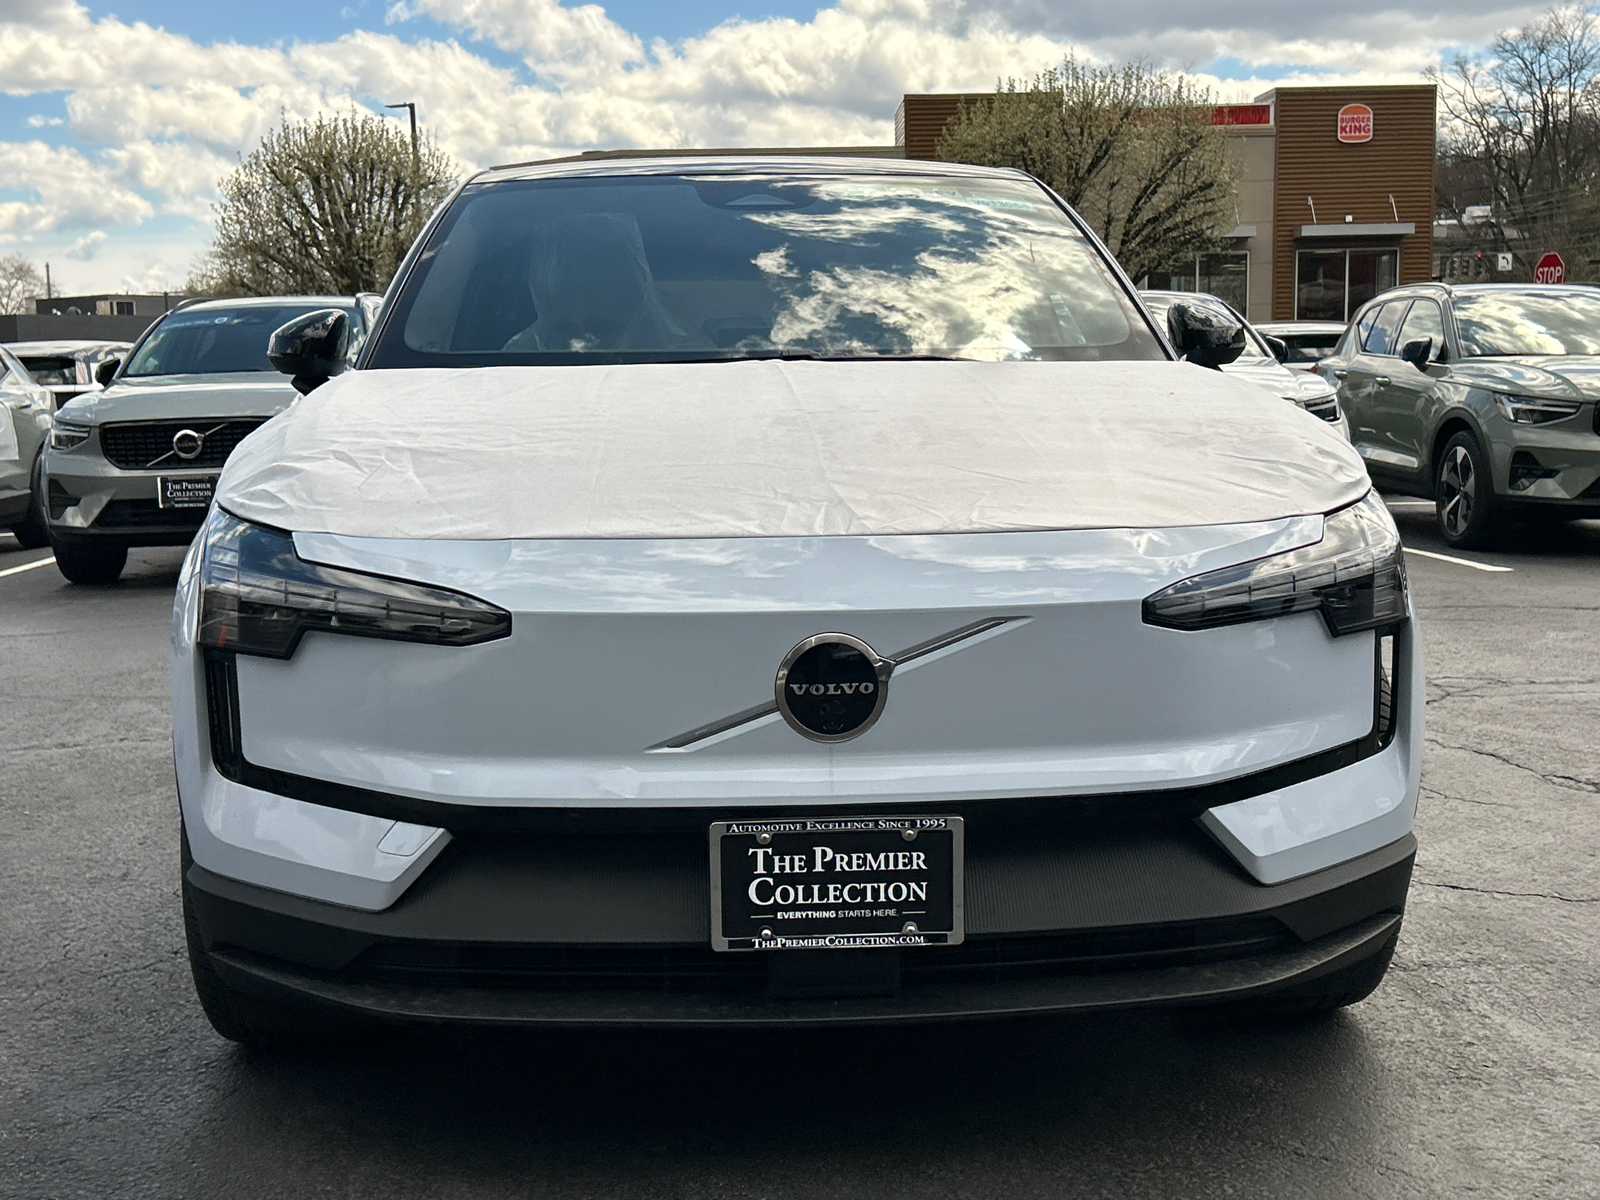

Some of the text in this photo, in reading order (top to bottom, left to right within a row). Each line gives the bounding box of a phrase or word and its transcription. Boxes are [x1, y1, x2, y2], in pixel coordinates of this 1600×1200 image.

[1340, 115, 1371, 124] BURGER
[1340, 124, 1371, 134] KING
[1536, 266, 1562, 284] STOP
[167, 490, 212, 498] COLLECTION
[789, 682, 874, 696] VOLVO
[729, 818, 946, 833] AUTOMOTIVE EXCELLENCE SINCE 1995
[748, 846, 928, 875] THE PREMIER
[748, 876, 928, 906] COLLECTION
[777, 909, 836, 920] EVERYTHING
[838, 909, 871, 918] STARTS
[752, 935, 925, 949] THEPREMIERCOLLECTION.COM
